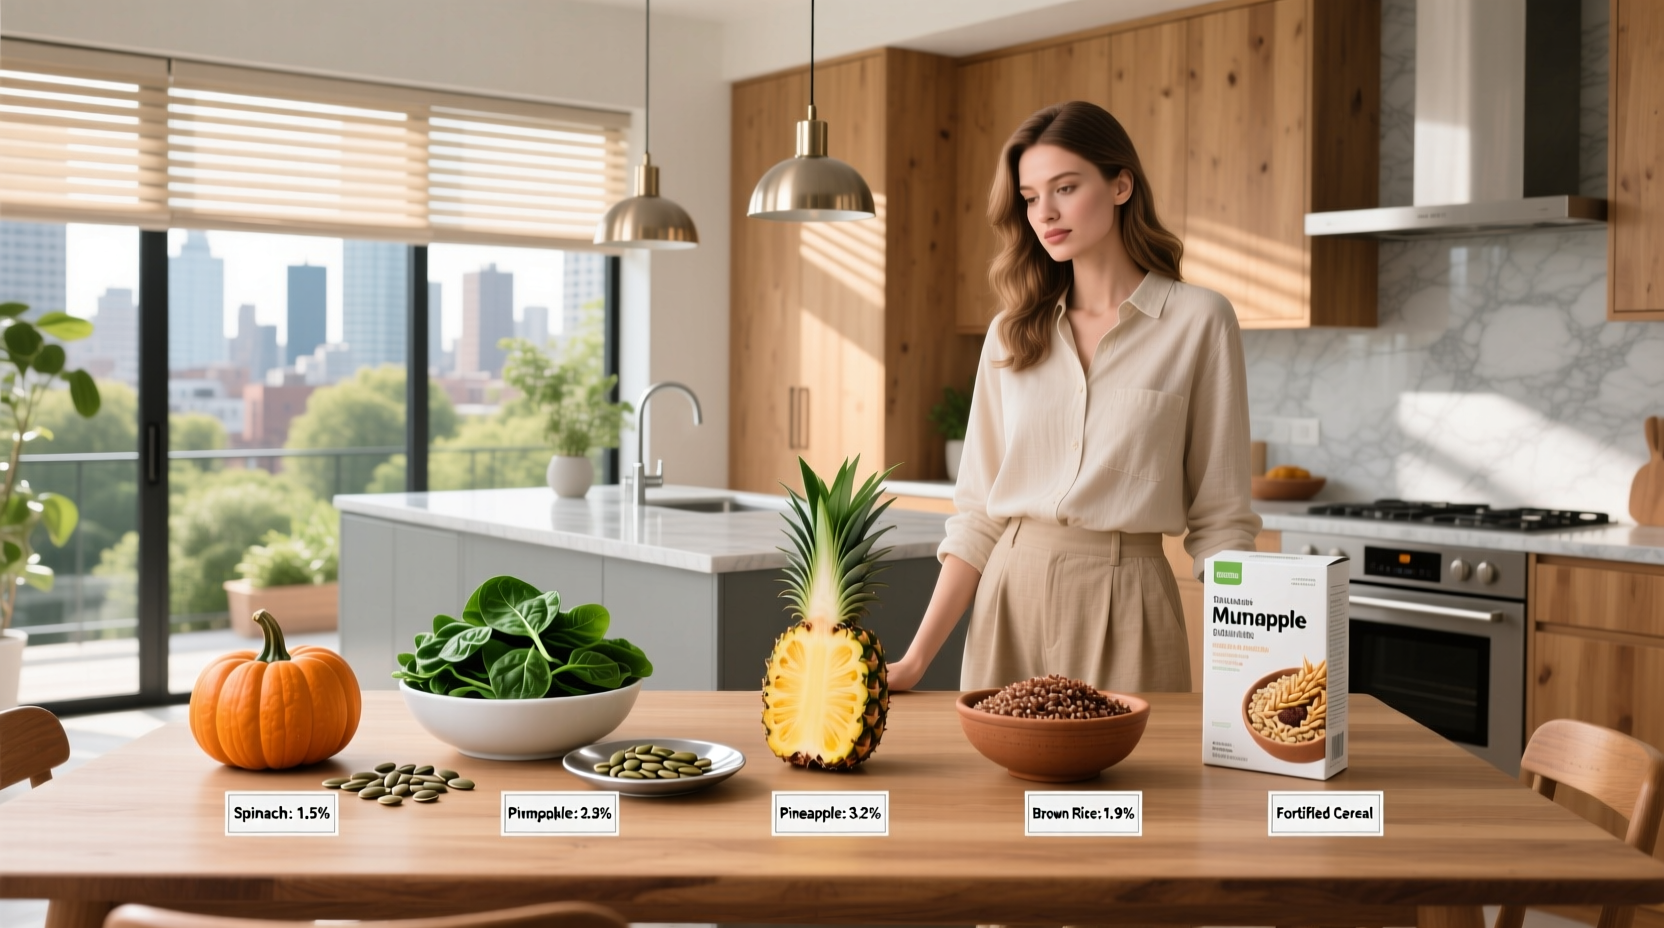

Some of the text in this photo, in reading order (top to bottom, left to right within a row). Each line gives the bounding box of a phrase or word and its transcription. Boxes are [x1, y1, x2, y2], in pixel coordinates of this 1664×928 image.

[1213, 606, 1307, 633] Munapple
[234, 805, 331, 823] Spinach: 1.5%
[779, 805, 847, 823] Pineapple:
[1032, 807, 1069, 820] Brown
[1103, 806, 1135, 820] 1.9%
[1333, 806, 1373, 820] Cereal
